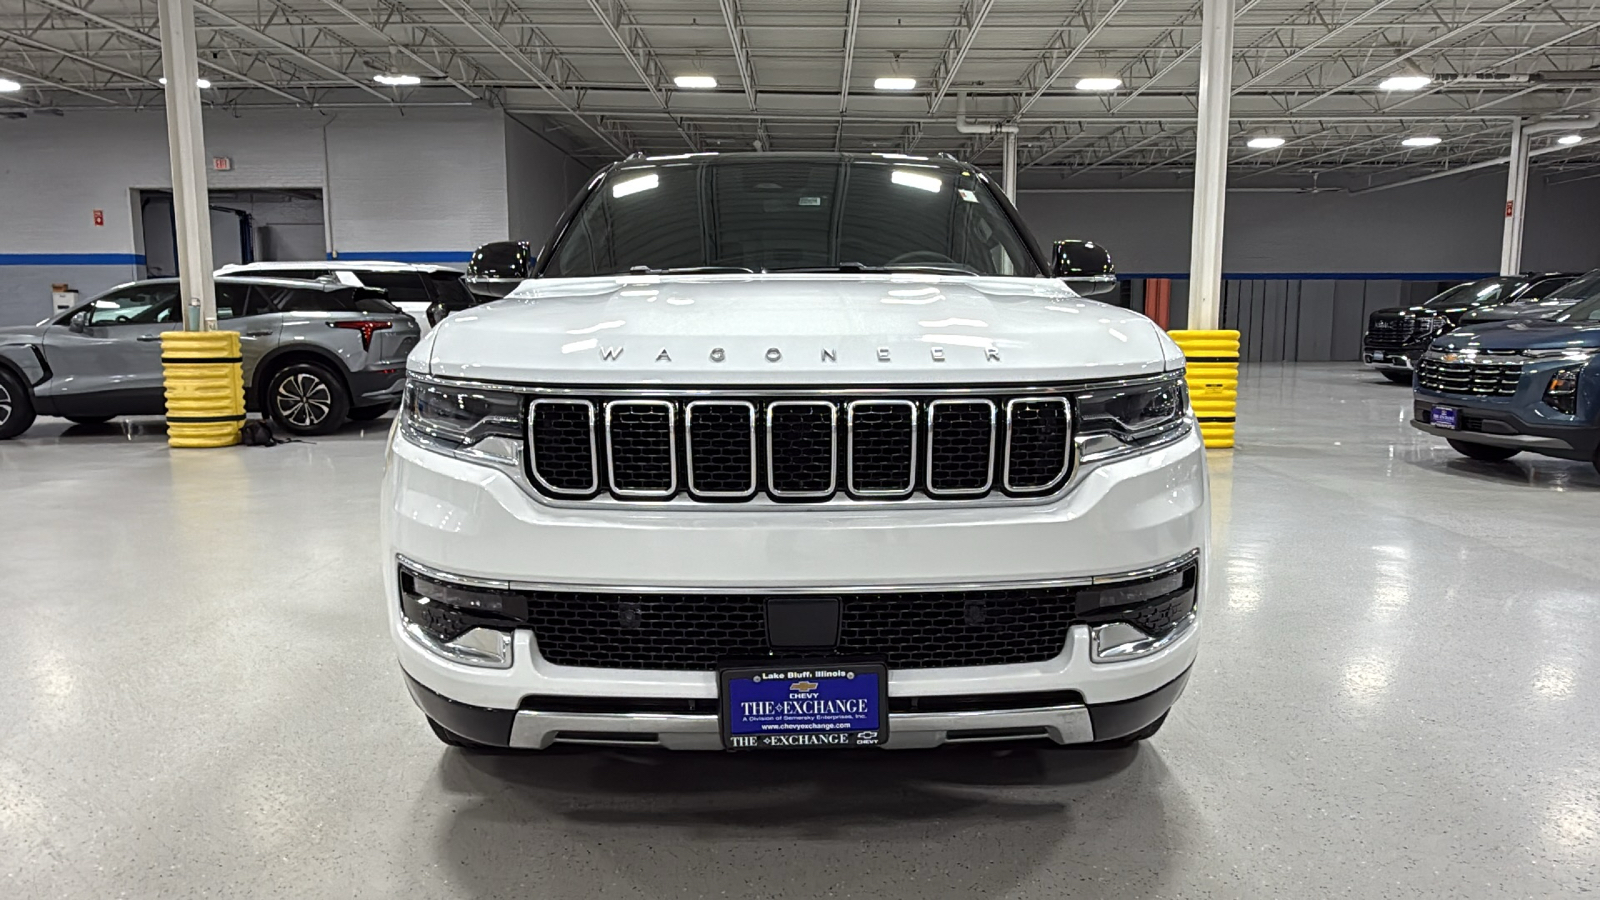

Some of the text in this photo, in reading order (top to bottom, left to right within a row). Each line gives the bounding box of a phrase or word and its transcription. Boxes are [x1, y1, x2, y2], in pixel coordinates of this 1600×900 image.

[600, 345, 1002, 363] WAGONEER
[741, 698, 868, 716] THE EXCHANGE
[761, 722, 851, 730] www.chevyexchange.com
[730, 733, 849, 746] THE EXCHANGE
